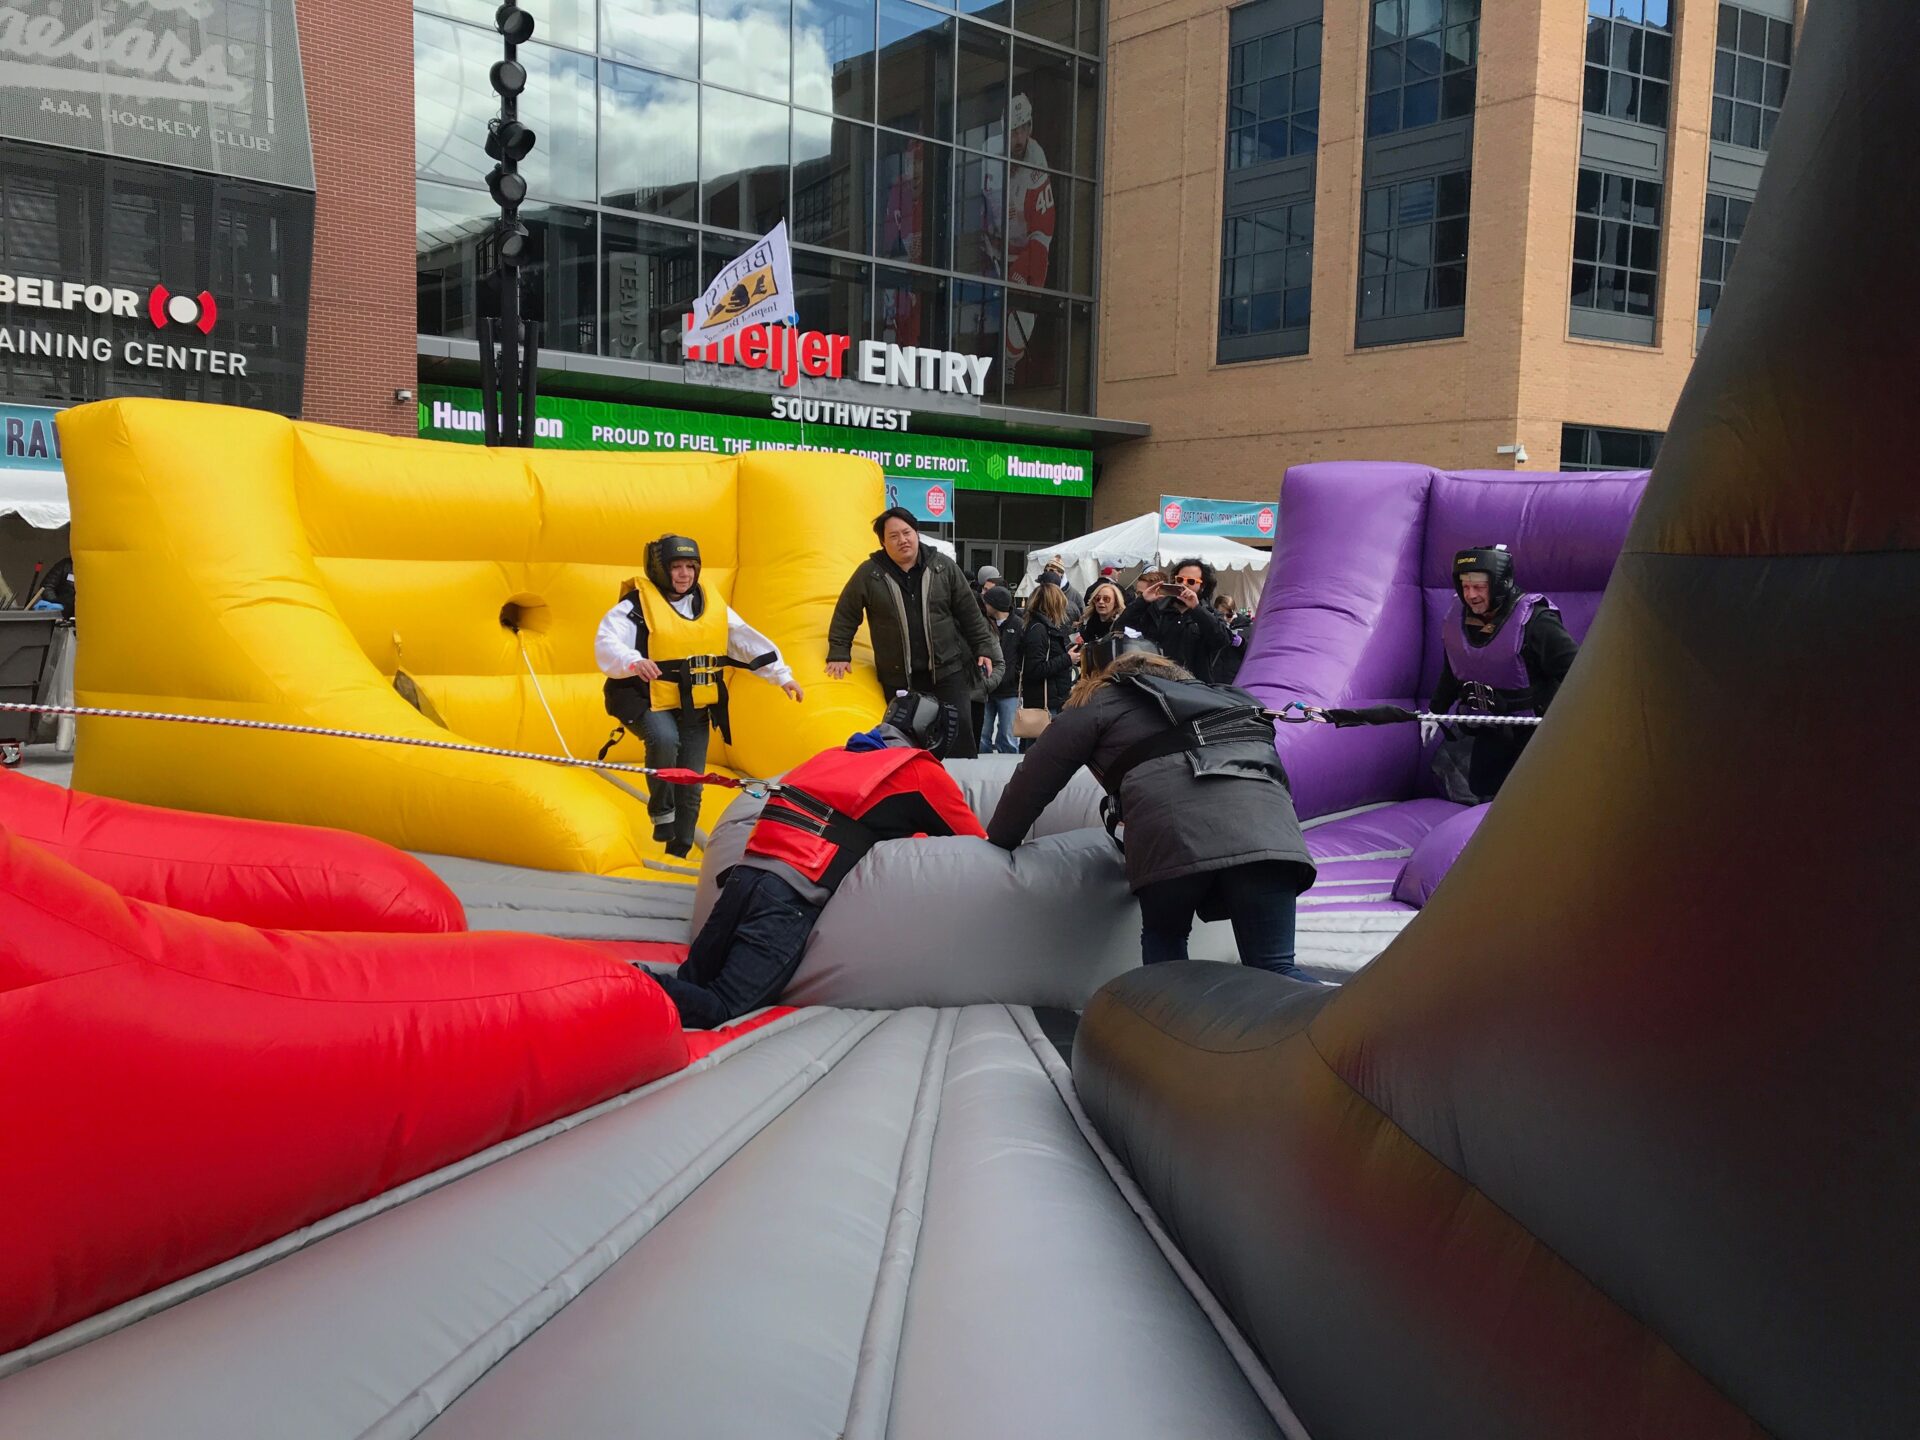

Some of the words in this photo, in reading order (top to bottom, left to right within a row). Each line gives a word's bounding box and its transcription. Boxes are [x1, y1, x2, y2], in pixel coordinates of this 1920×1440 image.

[39, 97, 92, 120] AAA
[102, 108, 201, 139] HOCKEY
[213, 129, 272, 152] CLUB
[1036, 183, 1055, 215] 40
[0, 274, 140, 318] BELFOR
[619, 259, 639, 326] TEAM
[0, 327, 112, 362] AINING
[124, 341, 247, 377] CENTER
[858, 340, 993, 396] ENTRY
[433, 401, 563, 438] Hunon
[592, 425, 650, 446] PROUD
[654, 431, 675, 448] TO
[680, 434, 719, 452] FUEL
[722, 437, 751, 453] THE
[849, 449, 892, 467] SPIRIT
[895, 453, 912, 469] OF
[915, 457, 970, 473] DETROIT.
[771, 397, 911, 432] SOUTHWEST
[1007, 455, 1084, 486] Huntington
[1183, 511, 1195, 522] SOFT
[1196, 512, 1214, 523] DRINKS
